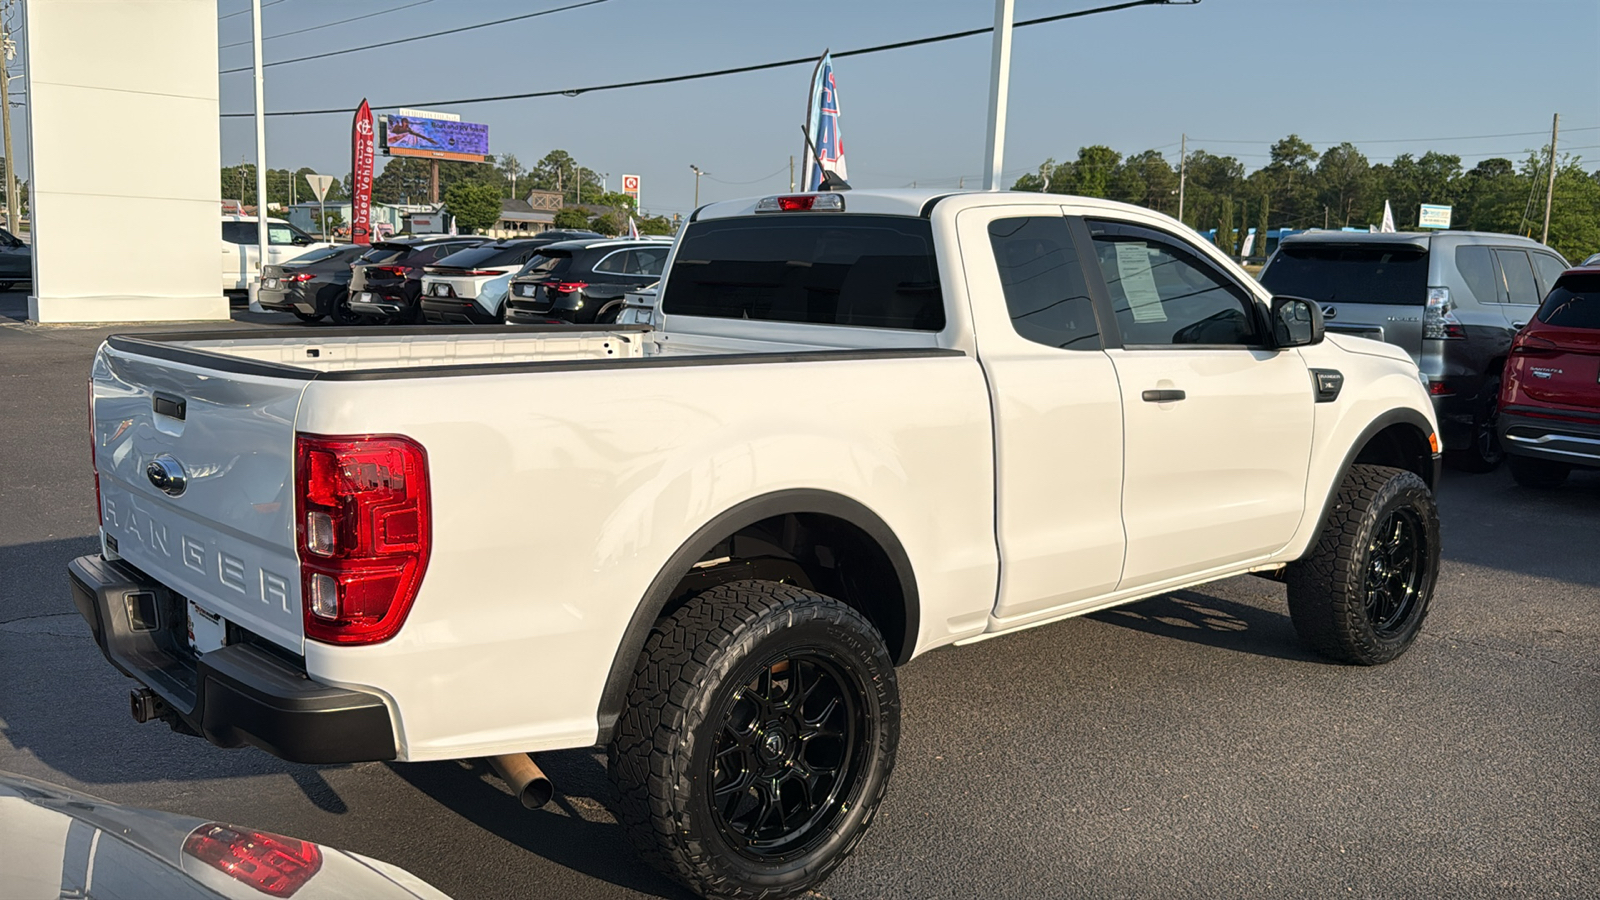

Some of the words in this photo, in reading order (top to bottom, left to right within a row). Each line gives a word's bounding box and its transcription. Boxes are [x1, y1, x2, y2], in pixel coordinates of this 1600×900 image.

[361, 140, 374, 190] Vehicles
[359, 195, 368, 223] Used
[103, 494, 292, 614] RANGER
